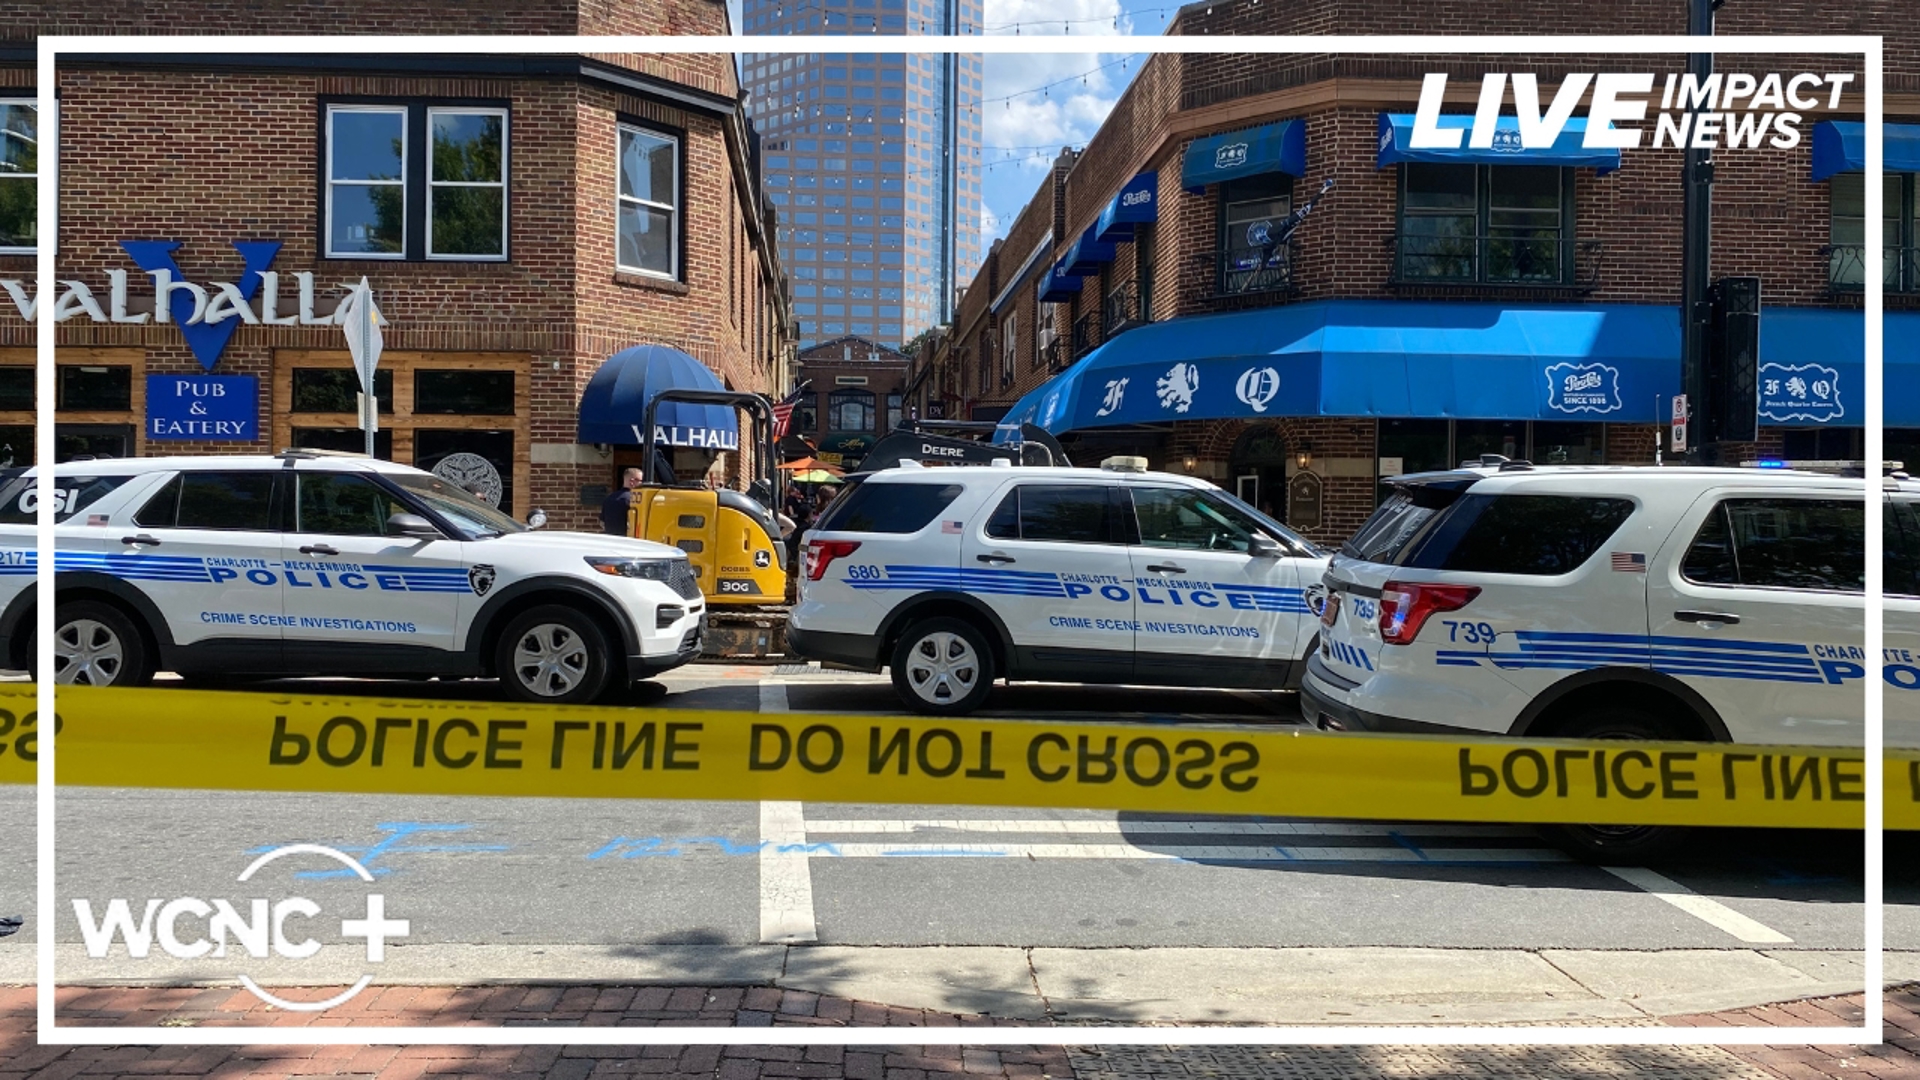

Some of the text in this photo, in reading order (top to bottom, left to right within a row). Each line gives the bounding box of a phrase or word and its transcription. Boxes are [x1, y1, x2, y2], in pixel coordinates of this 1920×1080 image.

[1235, 367, 1280, 412] Q
[1812, 380, 1830, 399] Q
[190, 402, 207, 415] &
[922, 443, 964, 458] DEERE
[206, 557, 362, 573] CHARLOTTE MECKLENBURG
[848, 565, 880, 580] 680
[208, 567, 407, 592] POLICE
[722, 581, 749, 592] 30G
[1061, 572, 1212, 590] CHARLOTTE MECKLENBURG
[1066, 582, 1258, 610] POLICE
[1353, 598, 1375, 620] 739
[200, 611, 417, 634] CRIME SCENE INVESTIGATIONS
[1050, 616, 1260, 639] CRIME SCENE INVESTIGATIONS
[1442, 621, 1496, 644] 739
[1813, 644, 1914, 663] CHARLTTE
